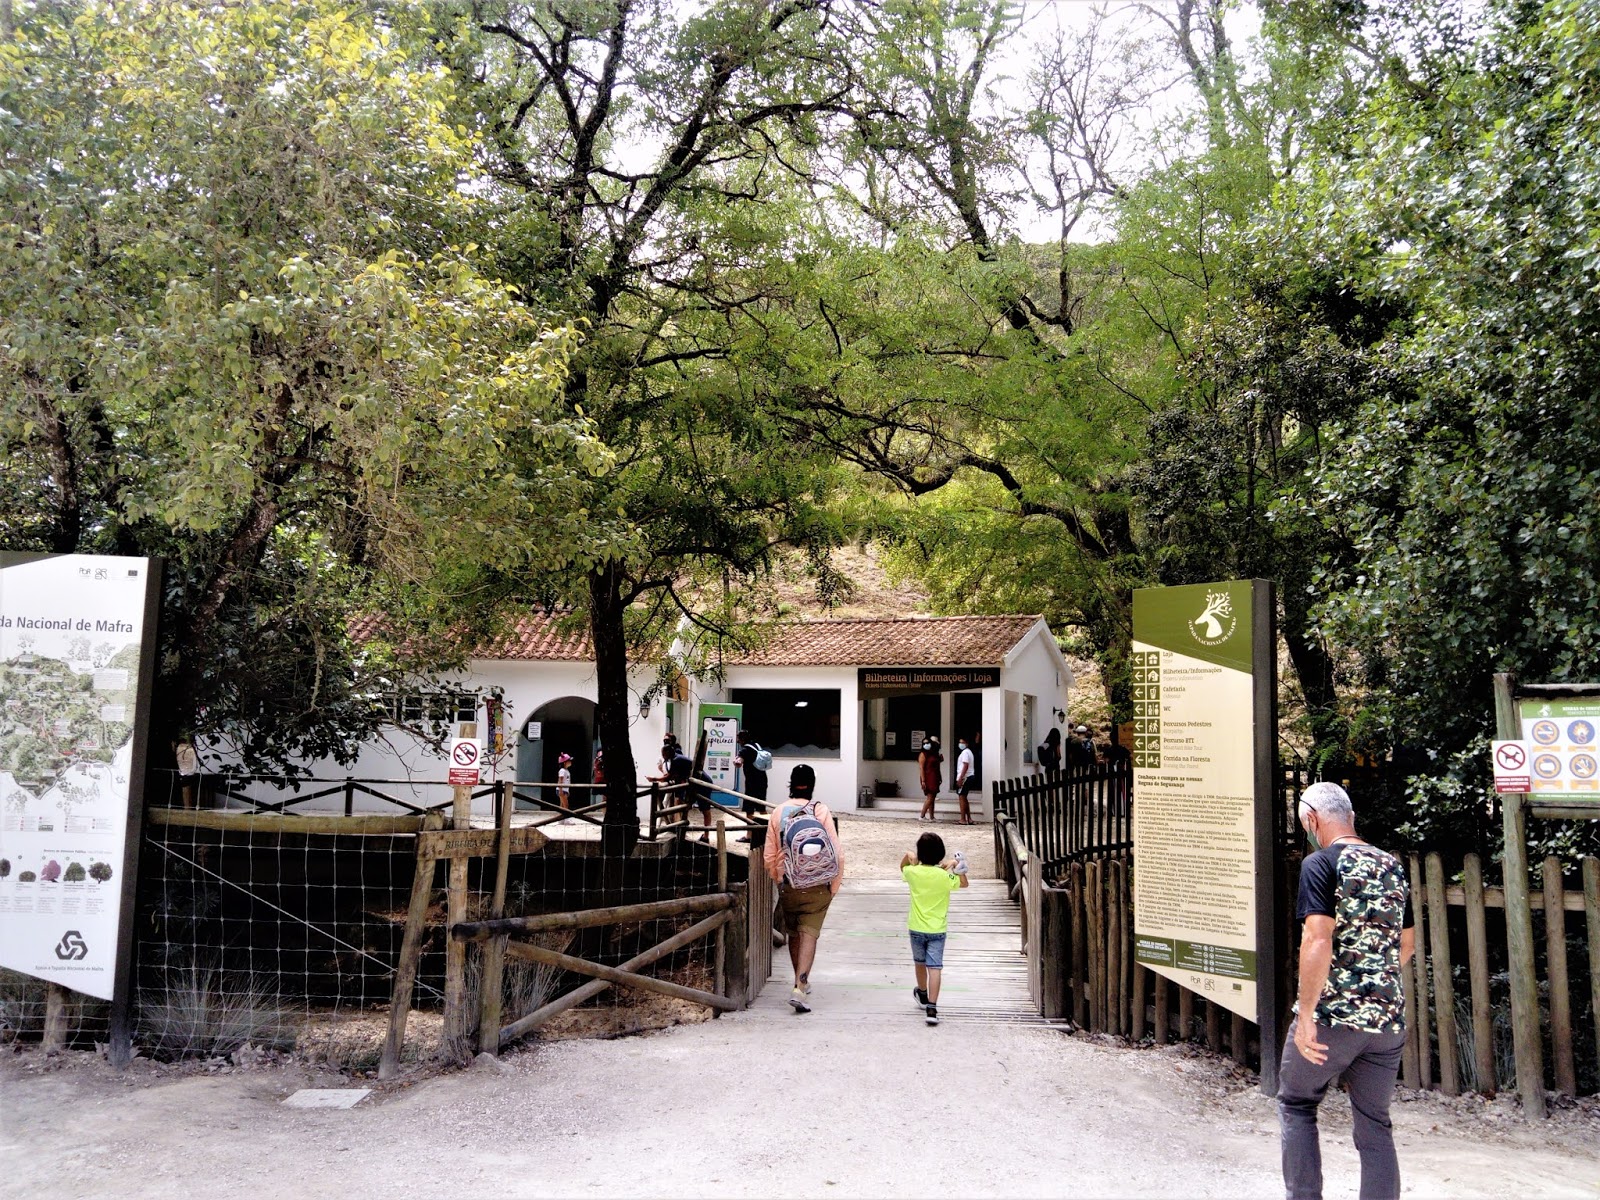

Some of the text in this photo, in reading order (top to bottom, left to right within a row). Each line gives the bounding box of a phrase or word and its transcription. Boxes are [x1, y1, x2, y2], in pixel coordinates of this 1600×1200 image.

[17, 616, 72, 630] Nacional
[76, 619, 91, 631] de
[96, 620, 133, 633] Mafra
[865, 672, 992, 684] Bilheteira Informações Loja
[446, 838, 478, 850] RIBEIRA
